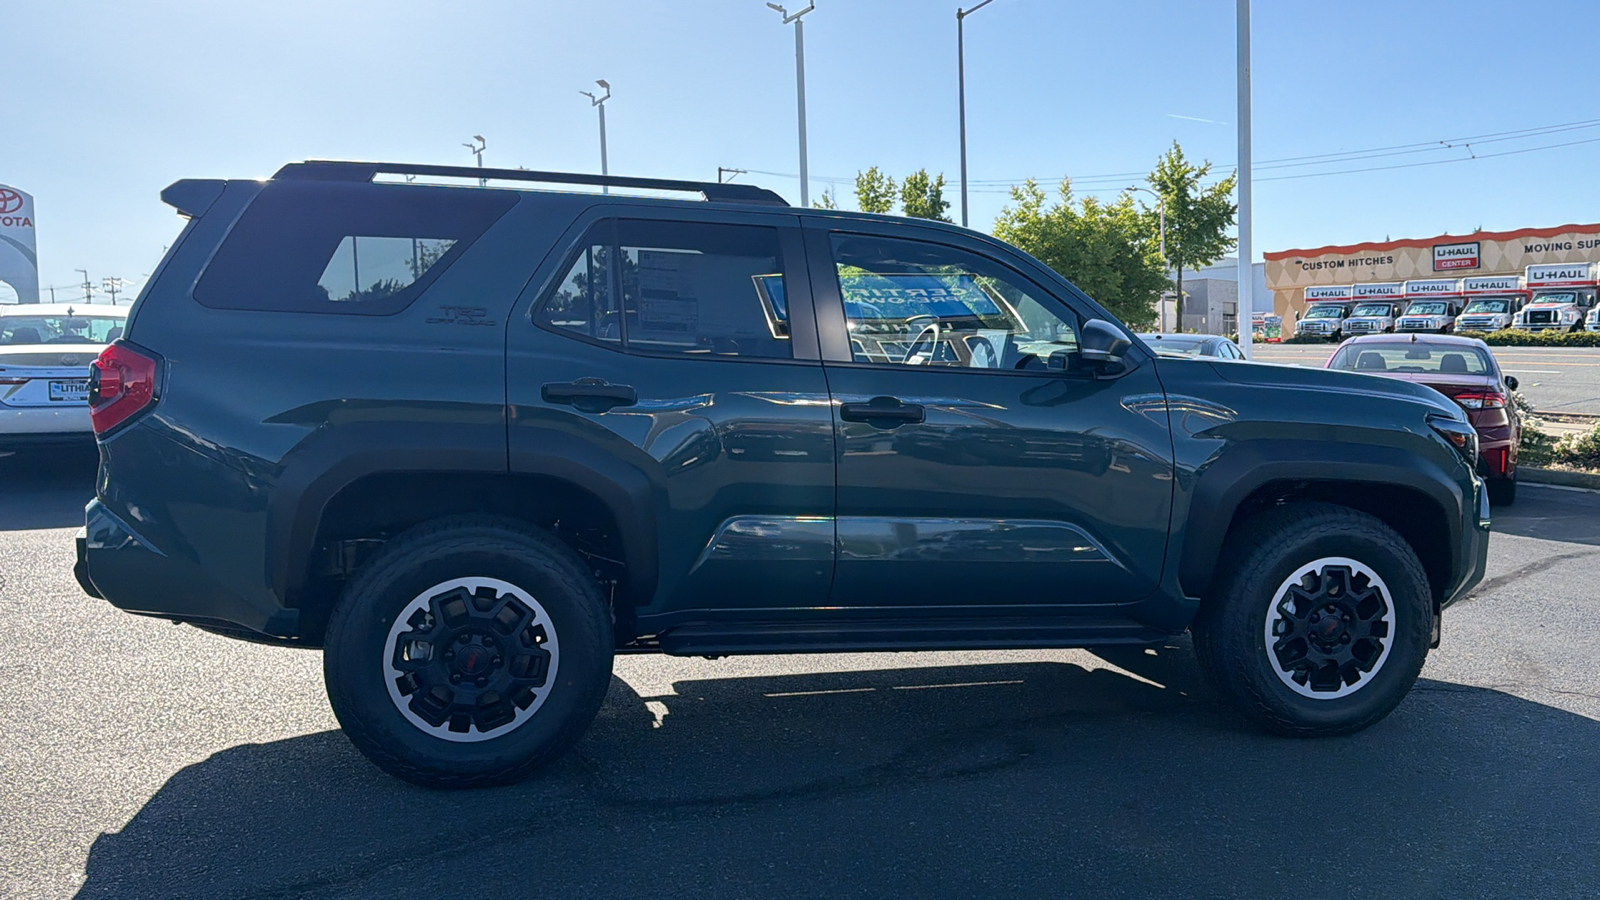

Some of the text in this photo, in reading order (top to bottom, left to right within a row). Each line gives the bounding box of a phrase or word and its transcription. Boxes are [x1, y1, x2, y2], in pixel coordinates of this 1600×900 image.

[1524, 239, 1600, 253] MOVING SUP
[1437, 247, 1475, 257] U-HAUL
[1302, 255, 1394, 271] CUSTOM HITCHES
[1441, 259, 1471, 268] CENTER
[1533, 269, 1585, 280] U-HAUL
[1469, 282, 1511, 290] U-HAUL
[1311, 290, 1347, 298] U-HAUL
[1358, 287, 1396, 295] U-HAUL
